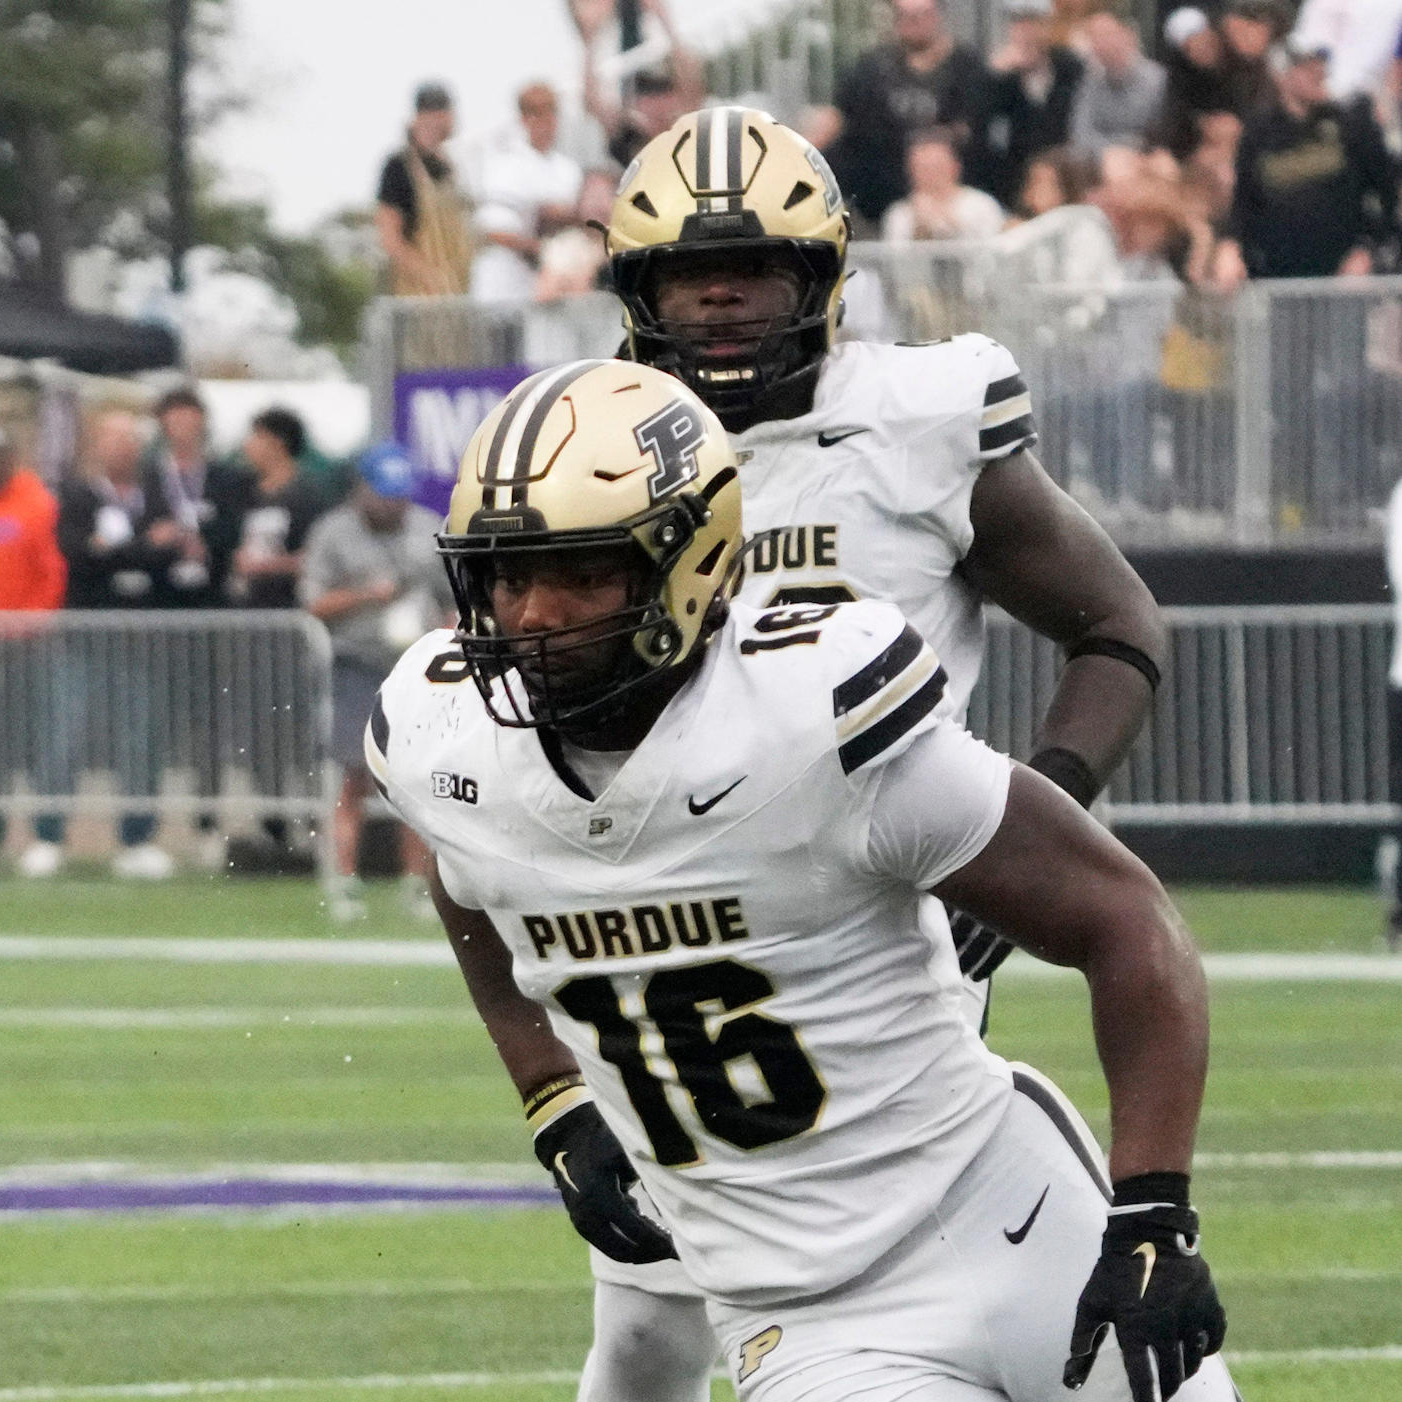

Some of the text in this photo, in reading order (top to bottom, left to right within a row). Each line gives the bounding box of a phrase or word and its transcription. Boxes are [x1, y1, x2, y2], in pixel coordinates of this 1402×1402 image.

[632, 397, 708, 506] P
[751, 523, 839, 574] DUE
[521, 896, 750, 961] PURDUE
[550, 955, 830, 1168] 16
[738, 1324, 783, 1384] P
